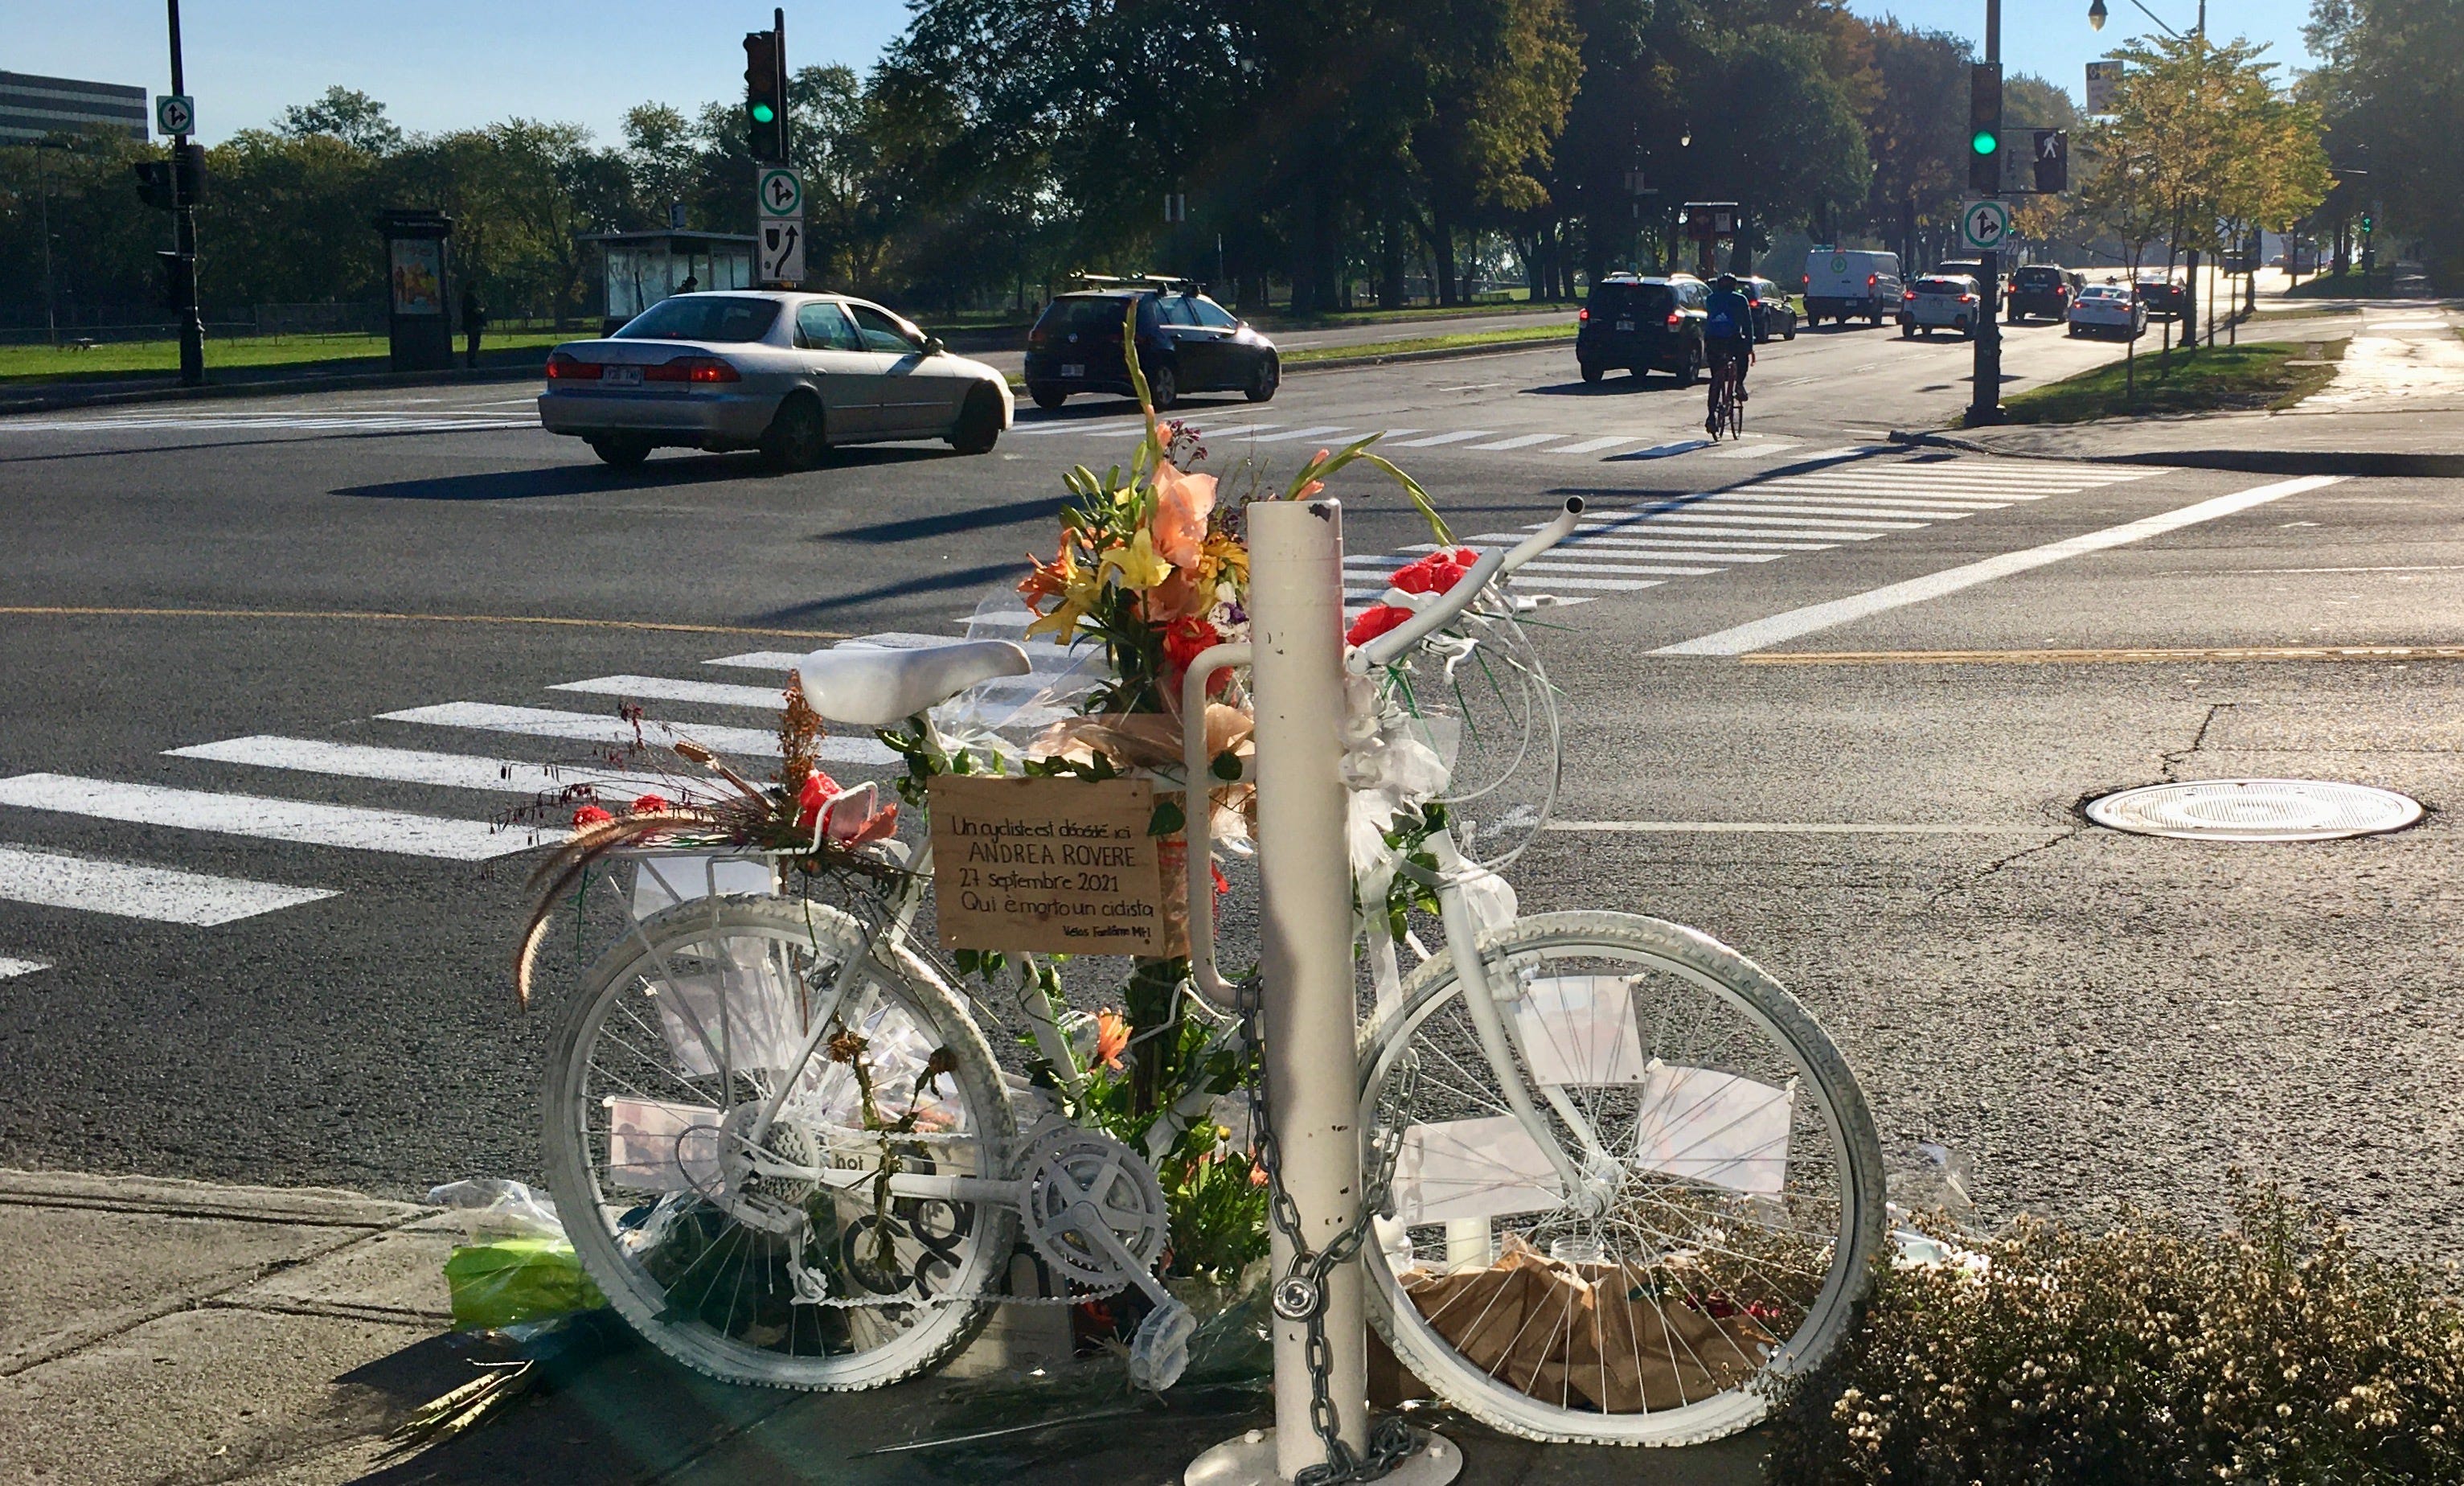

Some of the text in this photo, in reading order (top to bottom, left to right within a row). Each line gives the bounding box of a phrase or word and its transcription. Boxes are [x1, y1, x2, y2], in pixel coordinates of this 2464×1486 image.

[952, 815, 978, 837] Un
[1034, 821, 1054, 838] est
[968, 841, 1137, 867] ANDREA ROVERE
[958, 868, 1120, 893] 27 septembre 2021
[961, 891, 997, 913] Qui
[1019, 898, 1070, 916] morto
[1072, 902, 1097, 916] un
